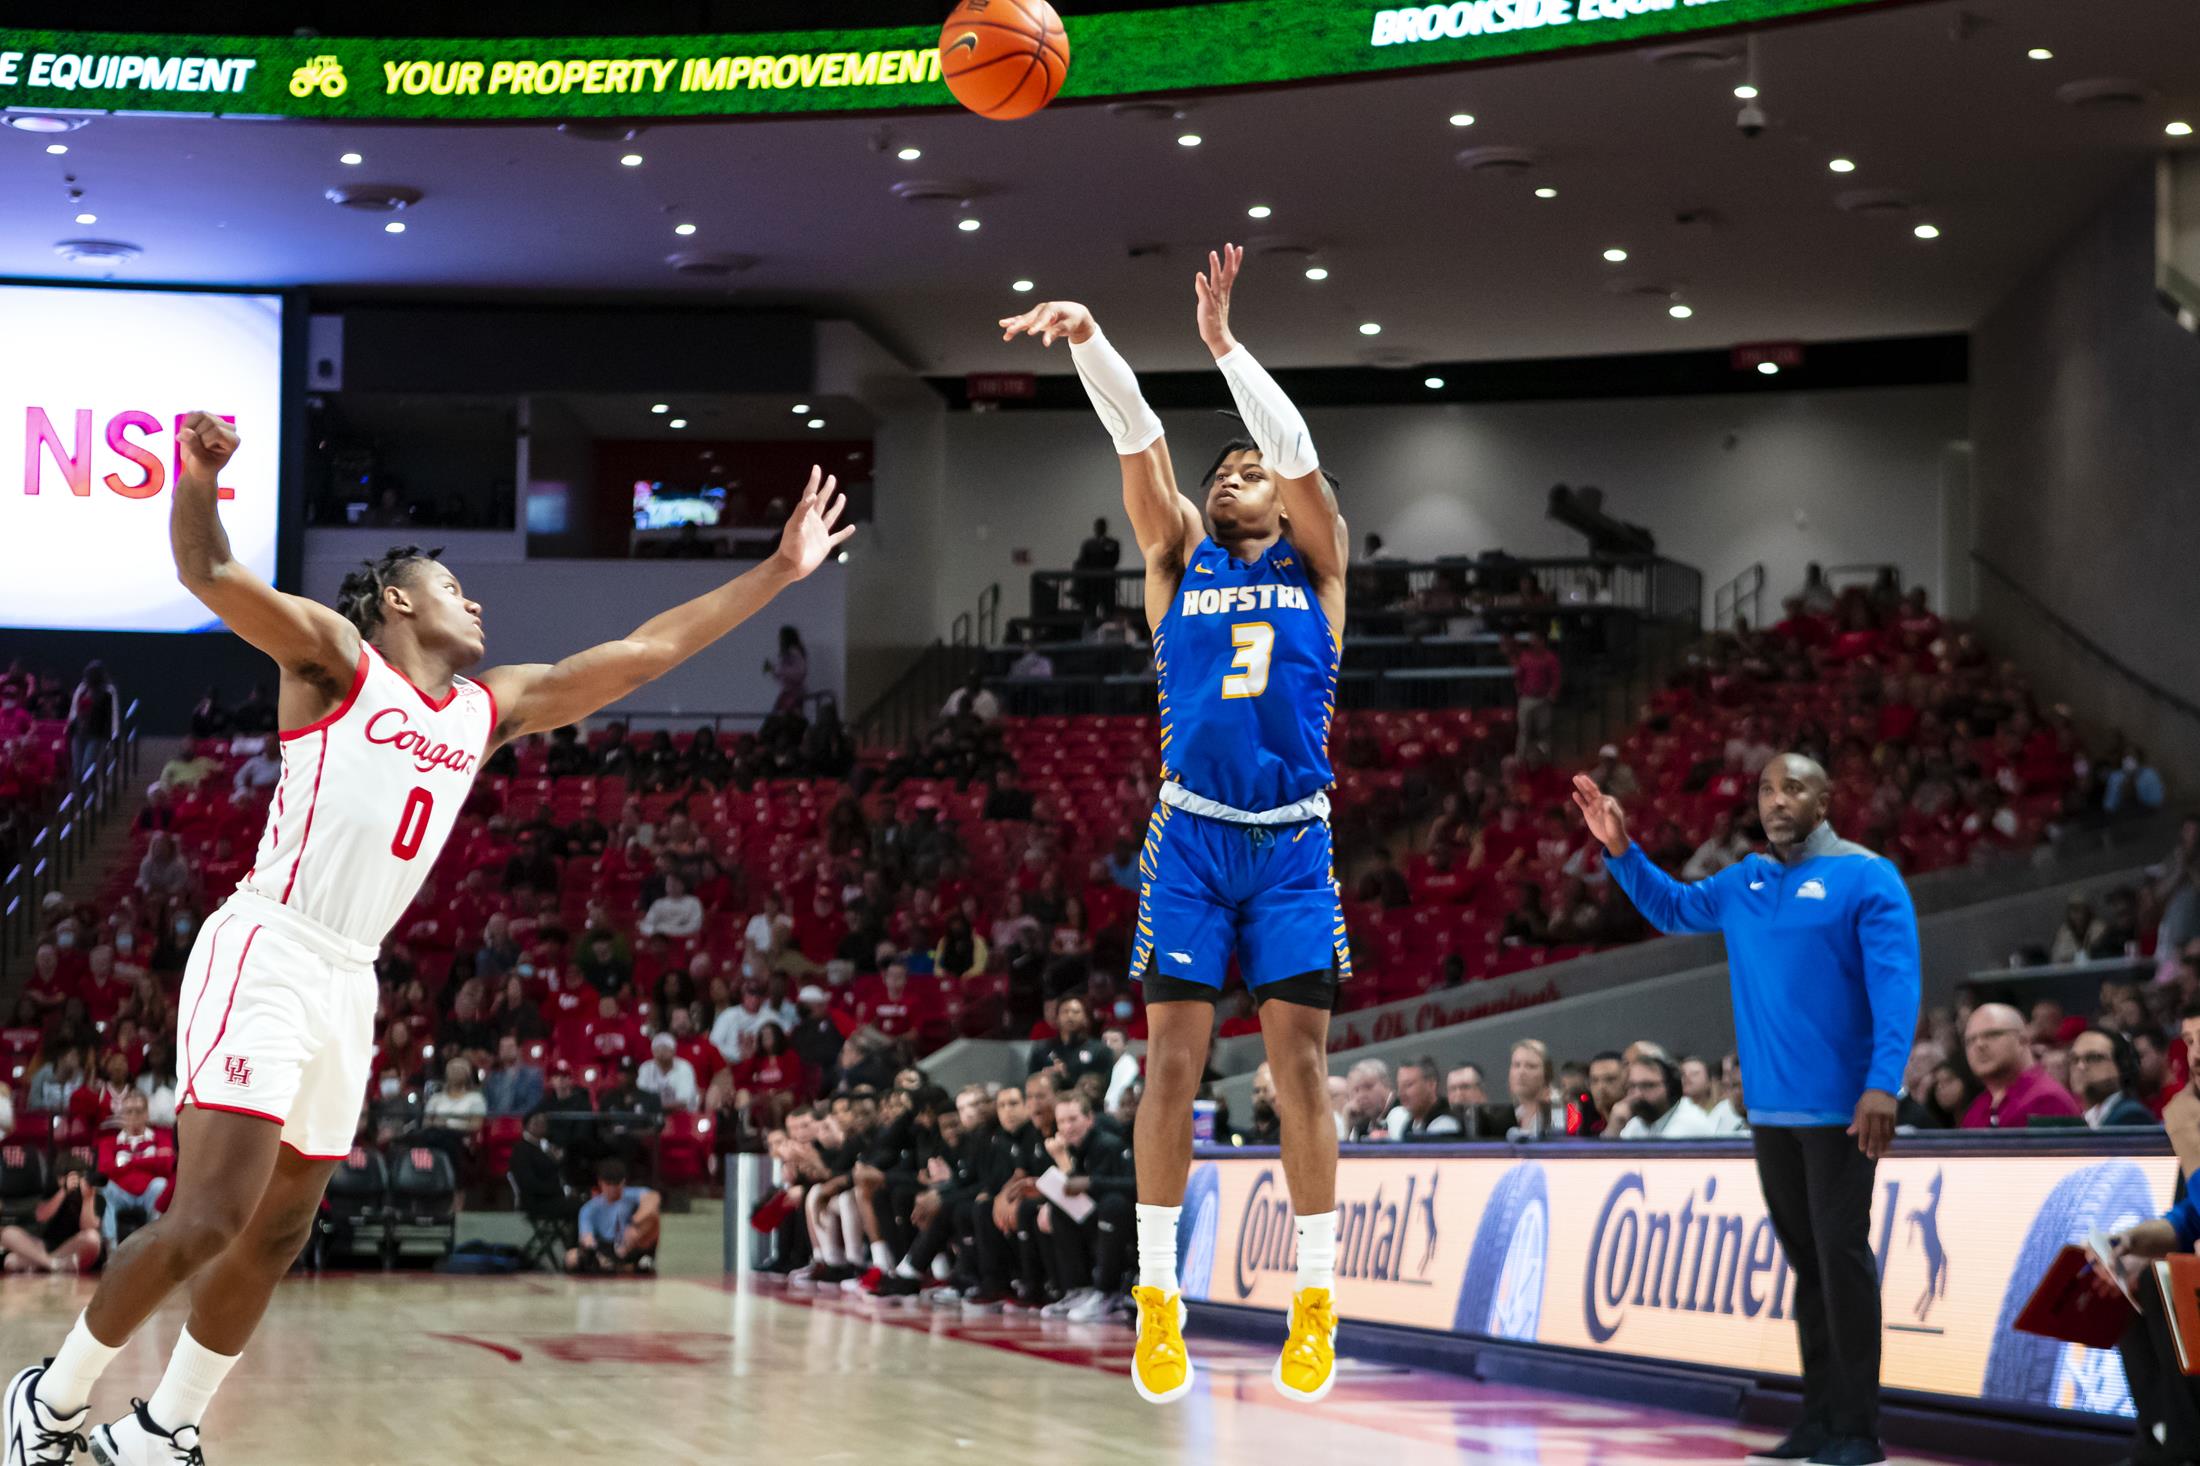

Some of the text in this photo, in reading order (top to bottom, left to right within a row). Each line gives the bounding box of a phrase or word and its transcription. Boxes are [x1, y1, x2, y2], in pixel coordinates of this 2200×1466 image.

[1370, 0, 1573, 46] BROOKSIDE
[27, 53, 257, 93] EQUIPMENT
[383, 47, 941, 96] YOUR PROPERTY IMPROVEMENT
[1182, 583, 1310, 616] HOFSTRA
[1222, 621, 1275, 699] 3
[364, 708, 477, 775] Cougar
[391, 786, 434, 861] 0
[1235, 1168, 1415, 1298] Conntal
[1583, 1168, 1899, 1343] Continel
